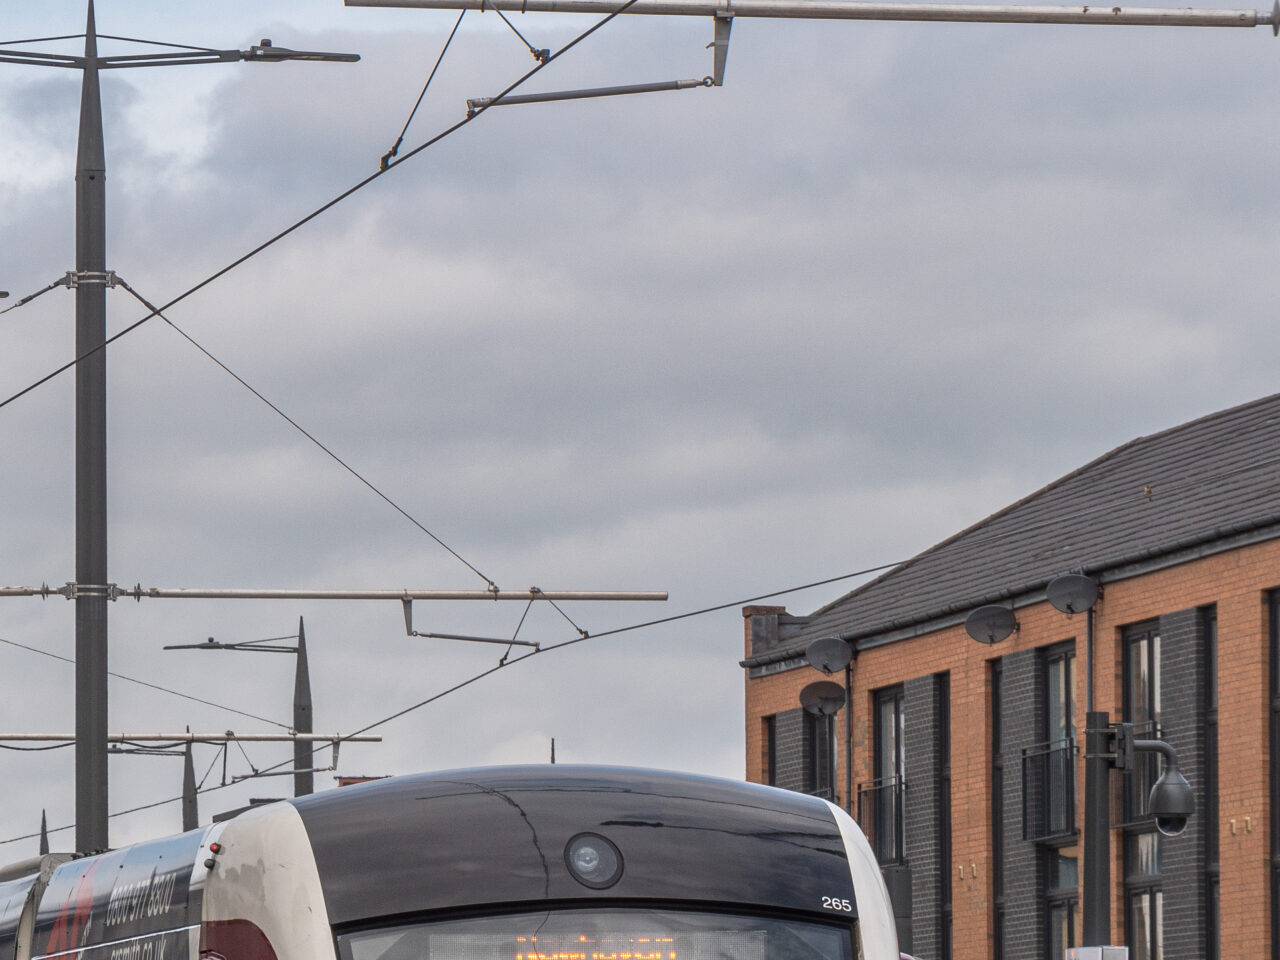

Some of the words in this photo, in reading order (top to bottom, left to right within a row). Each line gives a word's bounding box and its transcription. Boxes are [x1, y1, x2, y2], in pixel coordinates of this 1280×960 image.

[106, 882, 133, 927] 0800
[129, 878, 151, 921] 977
[147, 873, 177, 918] 8800
[821, 896, 852, 912] 265
